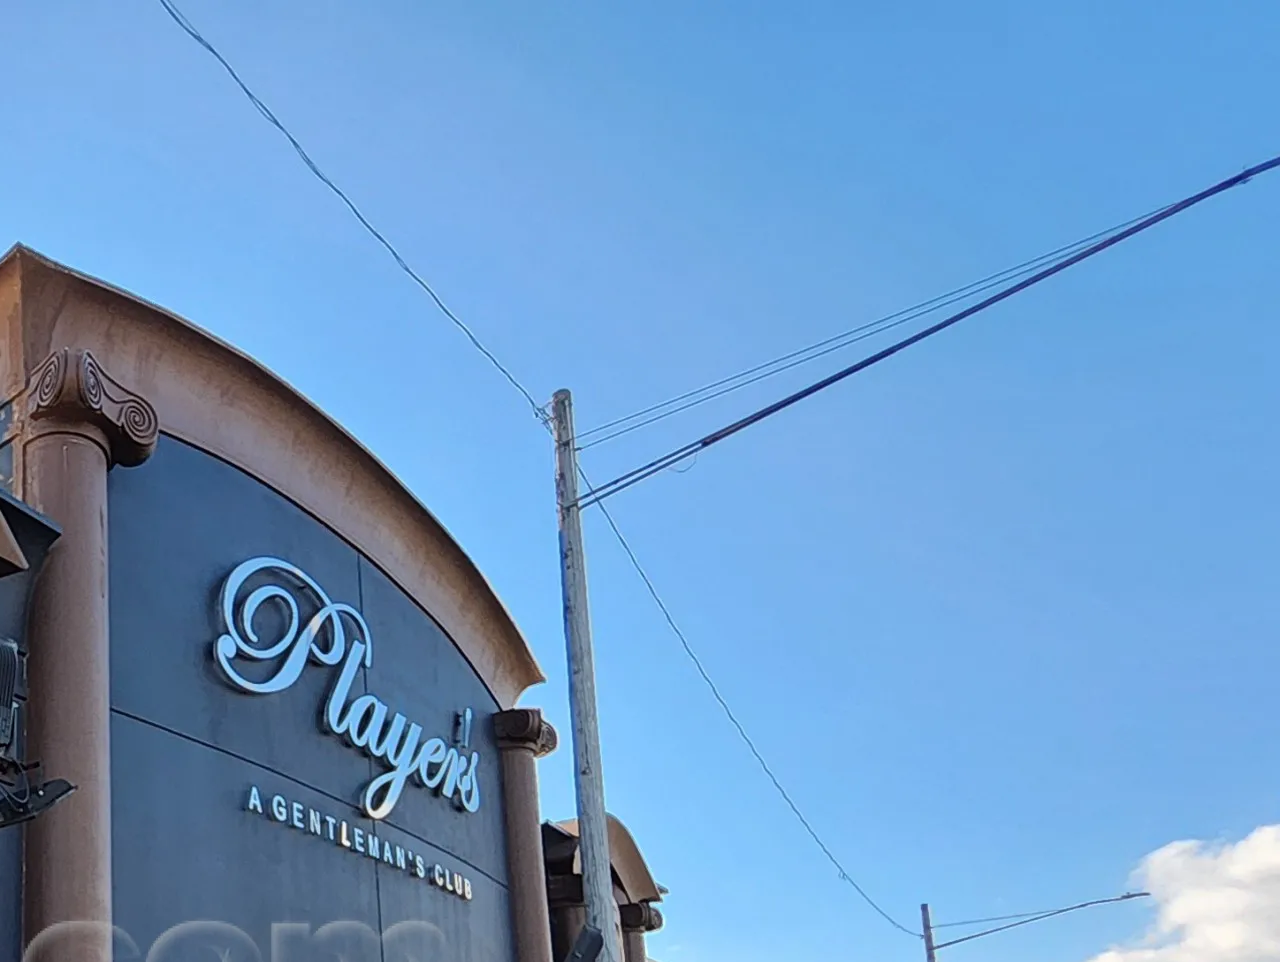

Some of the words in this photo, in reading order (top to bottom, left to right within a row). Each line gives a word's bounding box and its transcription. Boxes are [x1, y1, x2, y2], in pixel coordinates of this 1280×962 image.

[213, 556, 481, 820] Player's
[248, 785, 264, 815] A
[272, 795, 426, 879] GENTLEMAN'S
[433, 863, 473, 901] CLUB
